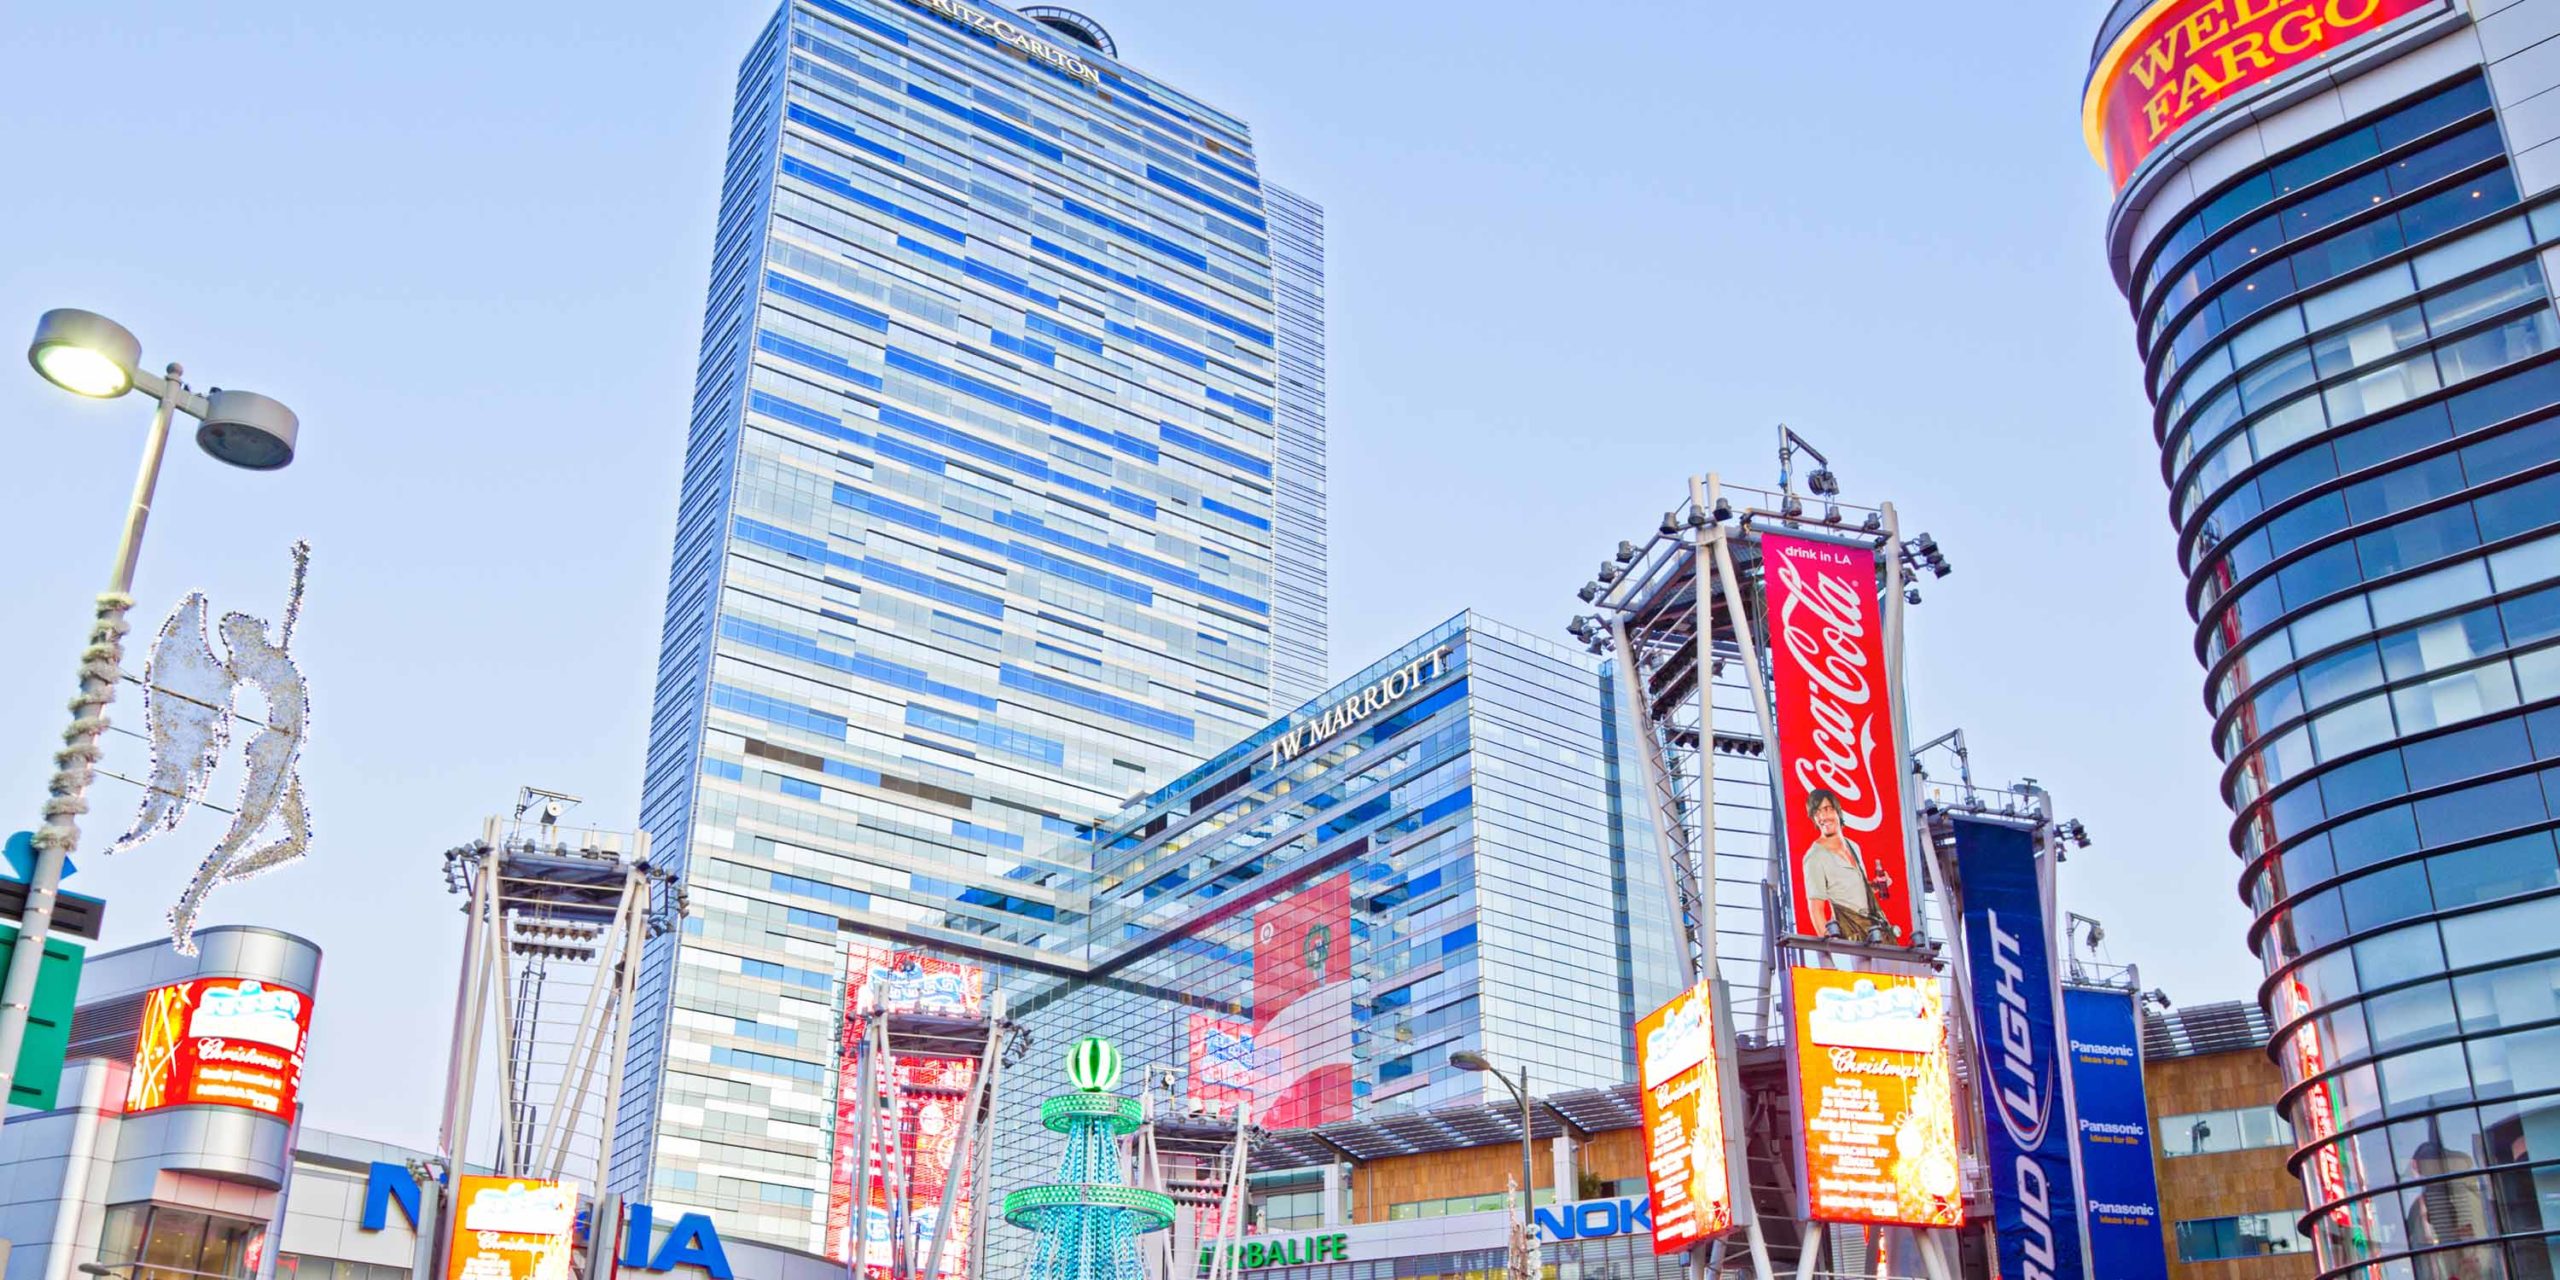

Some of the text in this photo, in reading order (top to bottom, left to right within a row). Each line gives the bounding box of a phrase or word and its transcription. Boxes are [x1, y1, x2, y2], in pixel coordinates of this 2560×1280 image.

[2143, 0, 2379, 142] FARGO
[1785, 546, 1852, 565] drink in LA
[1270, 645, 1450, 770] JW MARRIOTT
[1988, 908, 2041, 1125] LIGHT
[2070, 1040, 2134, 1057] Panasonic
[1828, 1046, 1920, 1078] Christmas
[2080, 1119, 2144, 1135] Panasonic
[2089, 1200, 2154, 1216] Panasonic
